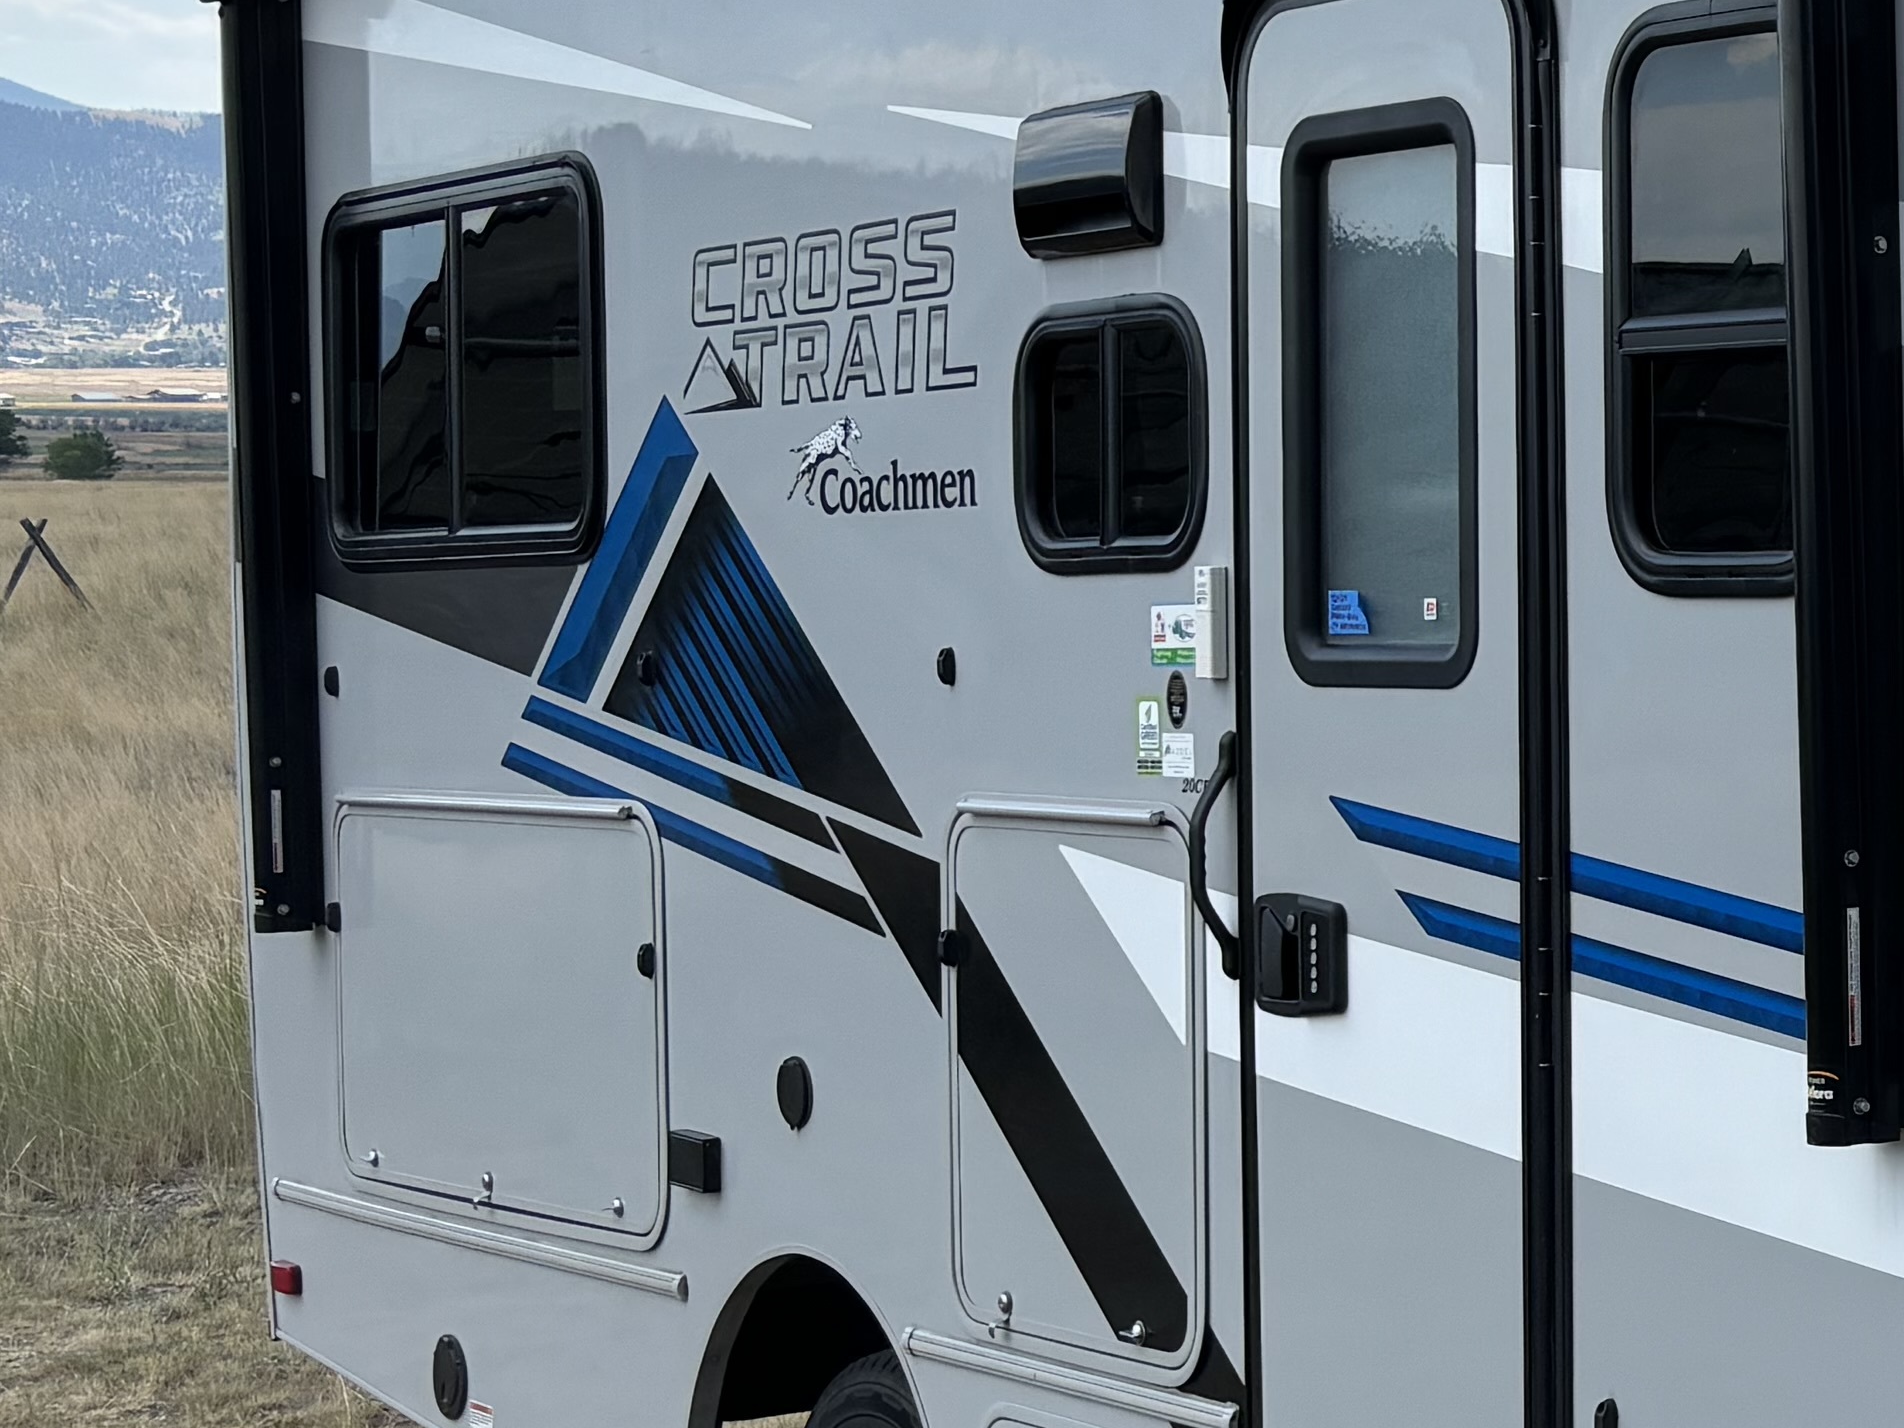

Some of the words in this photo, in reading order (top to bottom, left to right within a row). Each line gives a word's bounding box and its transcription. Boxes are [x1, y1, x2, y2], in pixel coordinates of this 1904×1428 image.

[692, 209, 957, 328] CROSS
[732, 304, 978, 408] TRAIL
[819, 460, 978, 516] Coachmen
